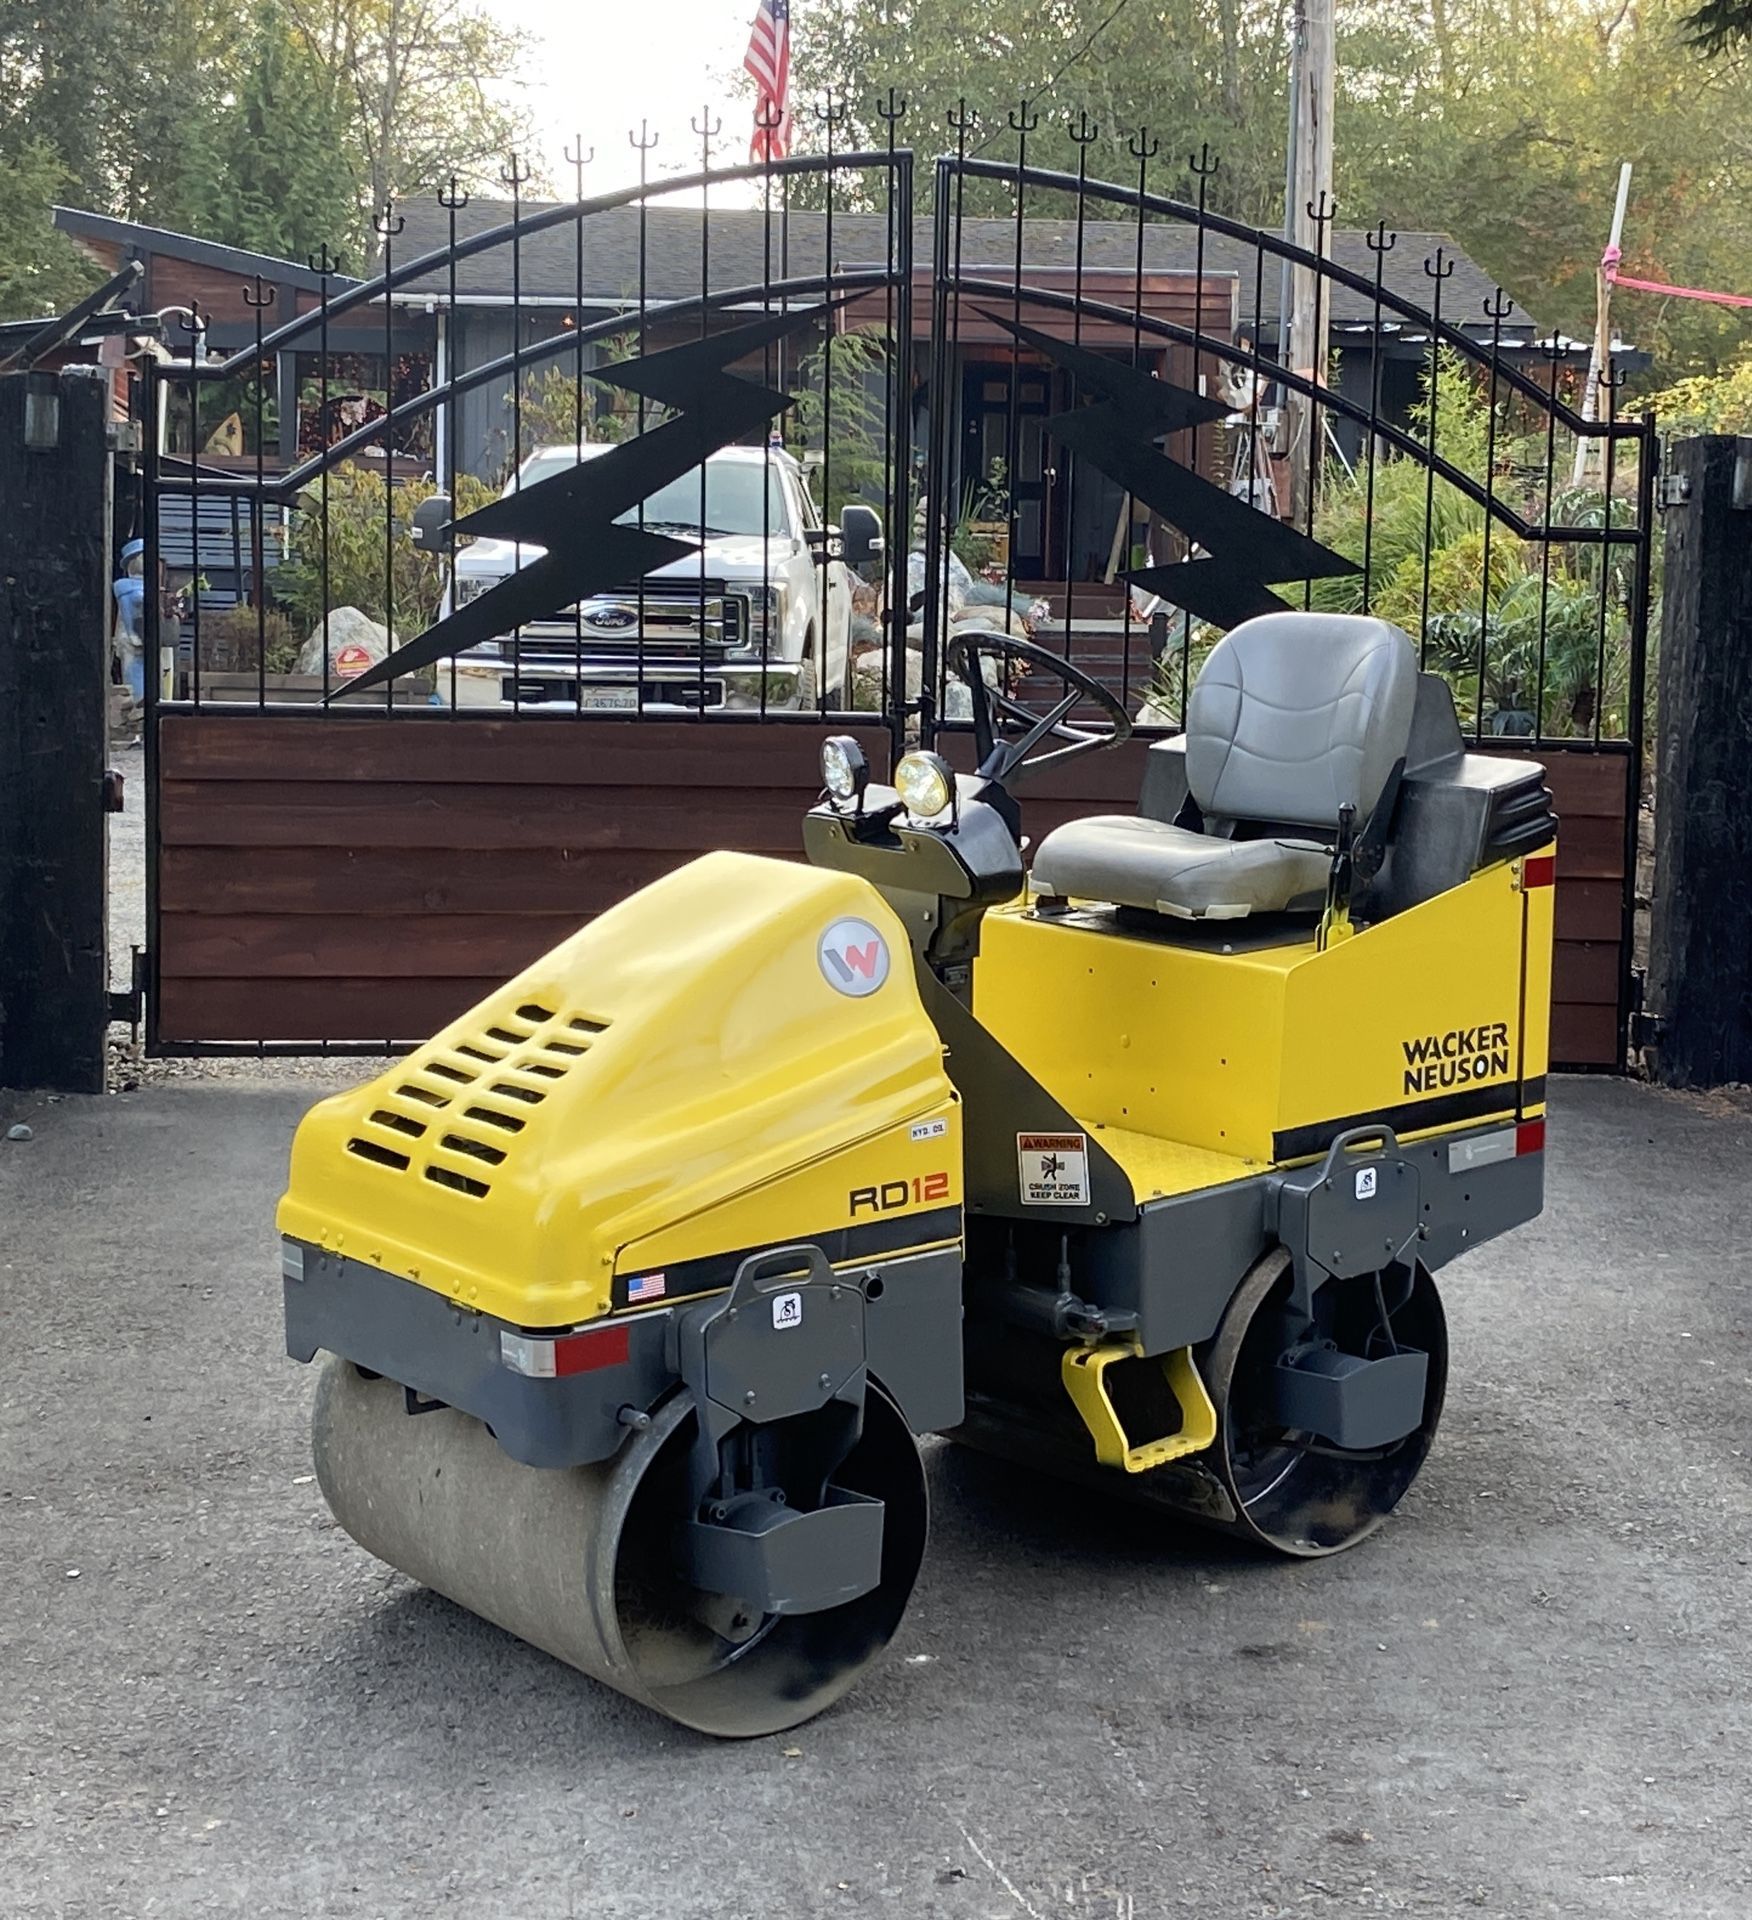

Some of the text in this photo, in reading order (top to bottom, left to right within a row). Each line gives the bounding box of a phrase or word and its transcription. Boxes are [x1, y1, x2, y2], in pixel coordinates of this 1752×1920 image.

[595, 611, 627, 626] Ford
[1402, 1022, 1509, 1066] WACKER
[1404, 1049, 1509, 1096] NEUSON
[1033, 1137, 1081, 1149] WARNING
[1029, 1182, 1057, 1191] CRUSH
[849, 1172, 949, 1217] RD12
[1030, 1191, 1080, 1200] KEEP CLEAR
